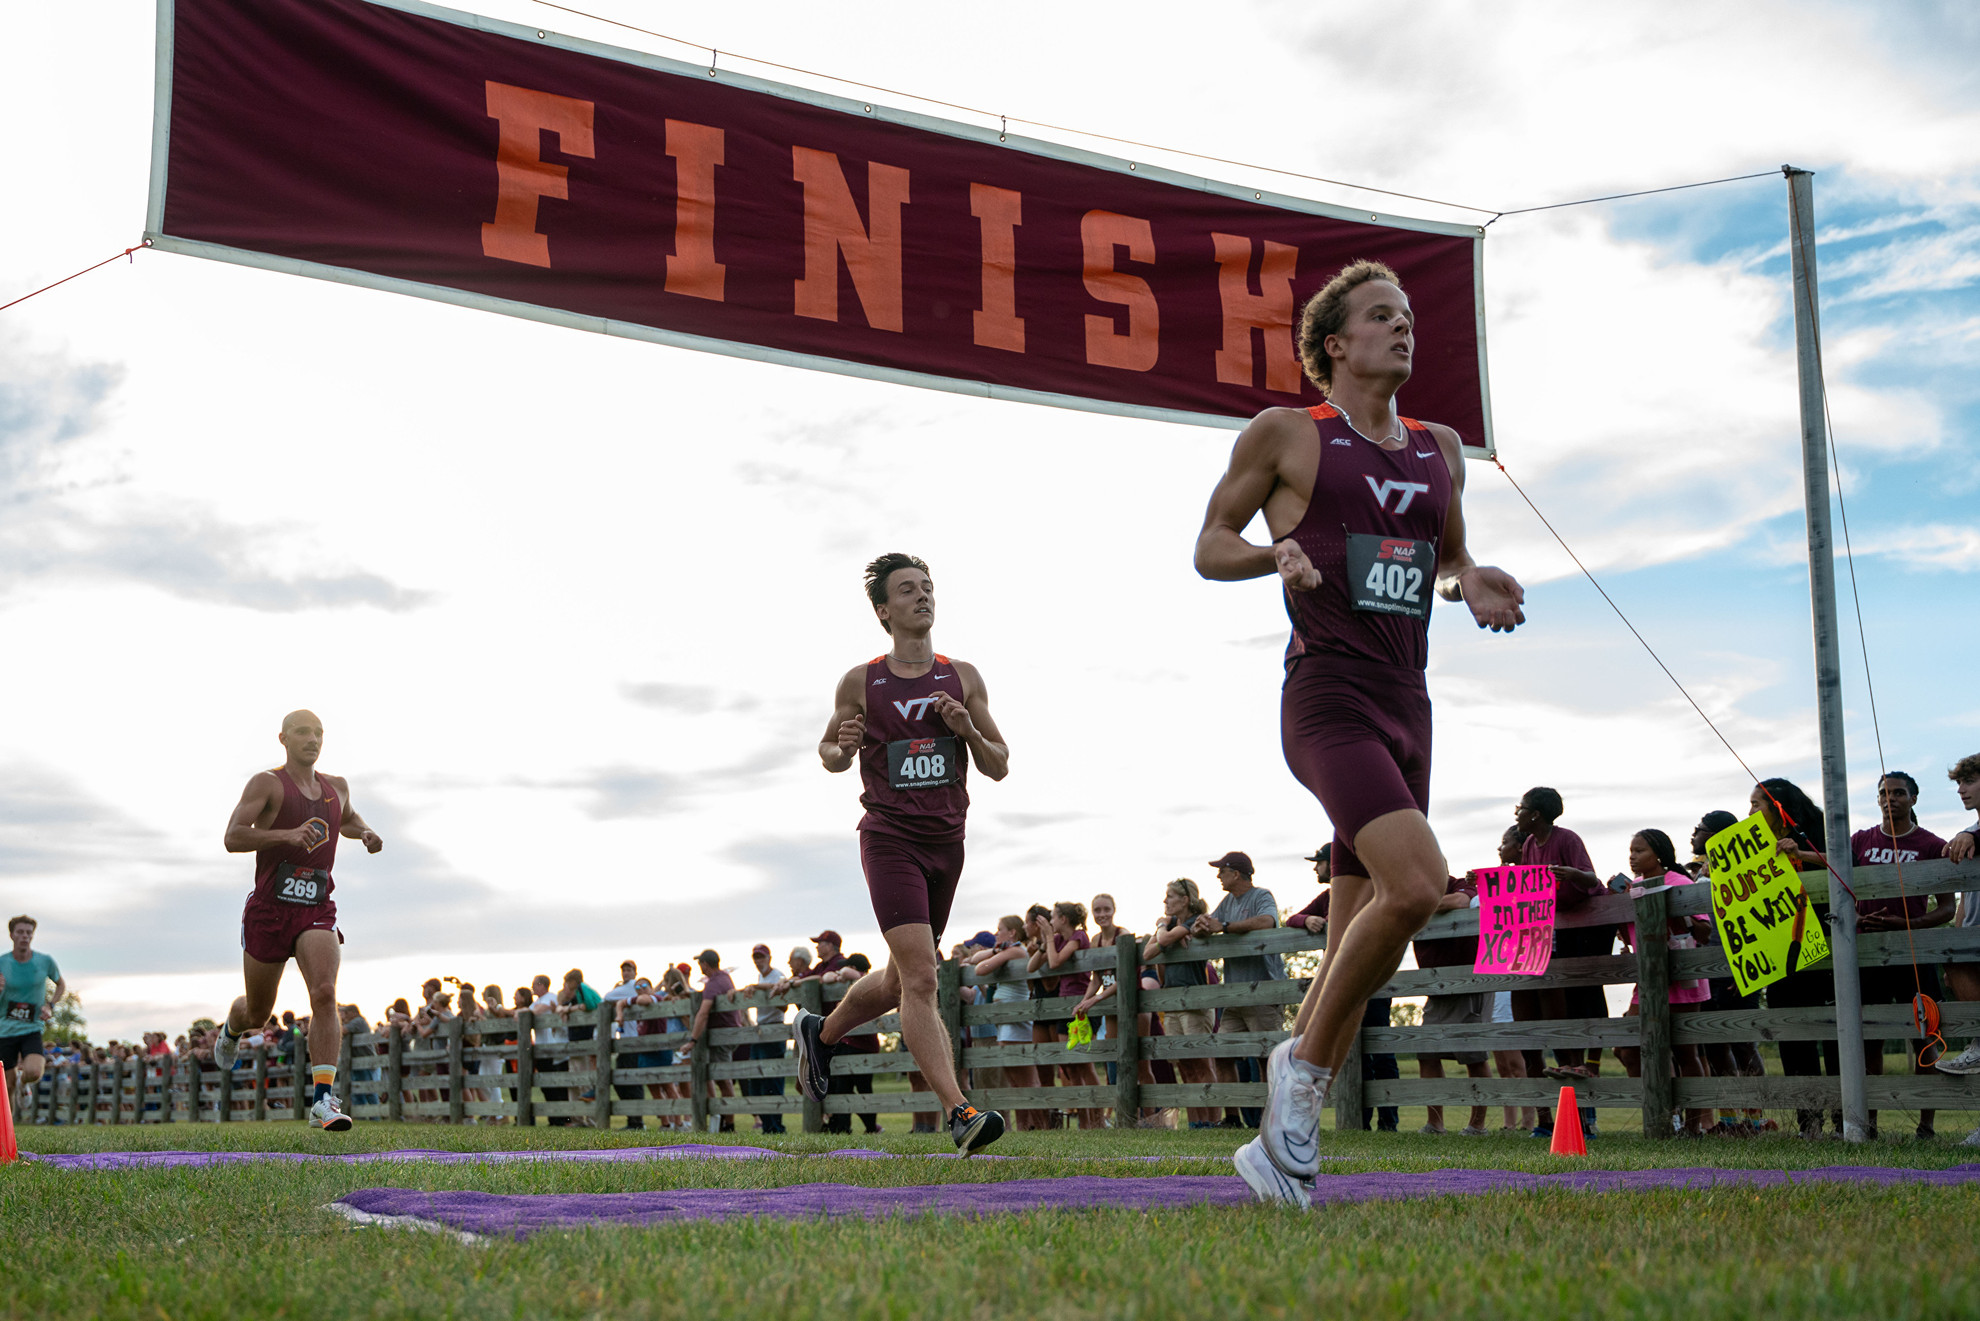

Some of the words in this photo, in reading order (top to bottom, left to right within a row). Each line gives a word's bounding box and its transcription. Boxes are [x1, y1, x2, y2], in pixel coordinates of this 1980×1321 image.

[481, 79, 1302, 394] FINISH
[1330, 438, 1352, 446] ACC
[1362, 474, 1431, 515] VT
[1377, 539, 1416, 560] SNAP
[1366, 562, 1423, 603] 402
[1357, 599, 1422, 615] www.snaptiming.com
[891, 696, 940, 722] VT
[907, 738, 936, 755] SNAP
[900, 754, 945, 779] 408
[895, 778, 949, 788] www.snaptiming.com
[282, 877, 318, 899] 269
[1484, 866, 1552, 898] HOKIES
[1516, 898, 1554, 924] THEIR
[1481, 930, 1513, 965] XC
[1511, 924, 1553, 972] ERA
[1723, 916, 1757, 955] BE
[1805, 929, 1820, 944] Go
[1732, 950, 1777, 989] YOU!
